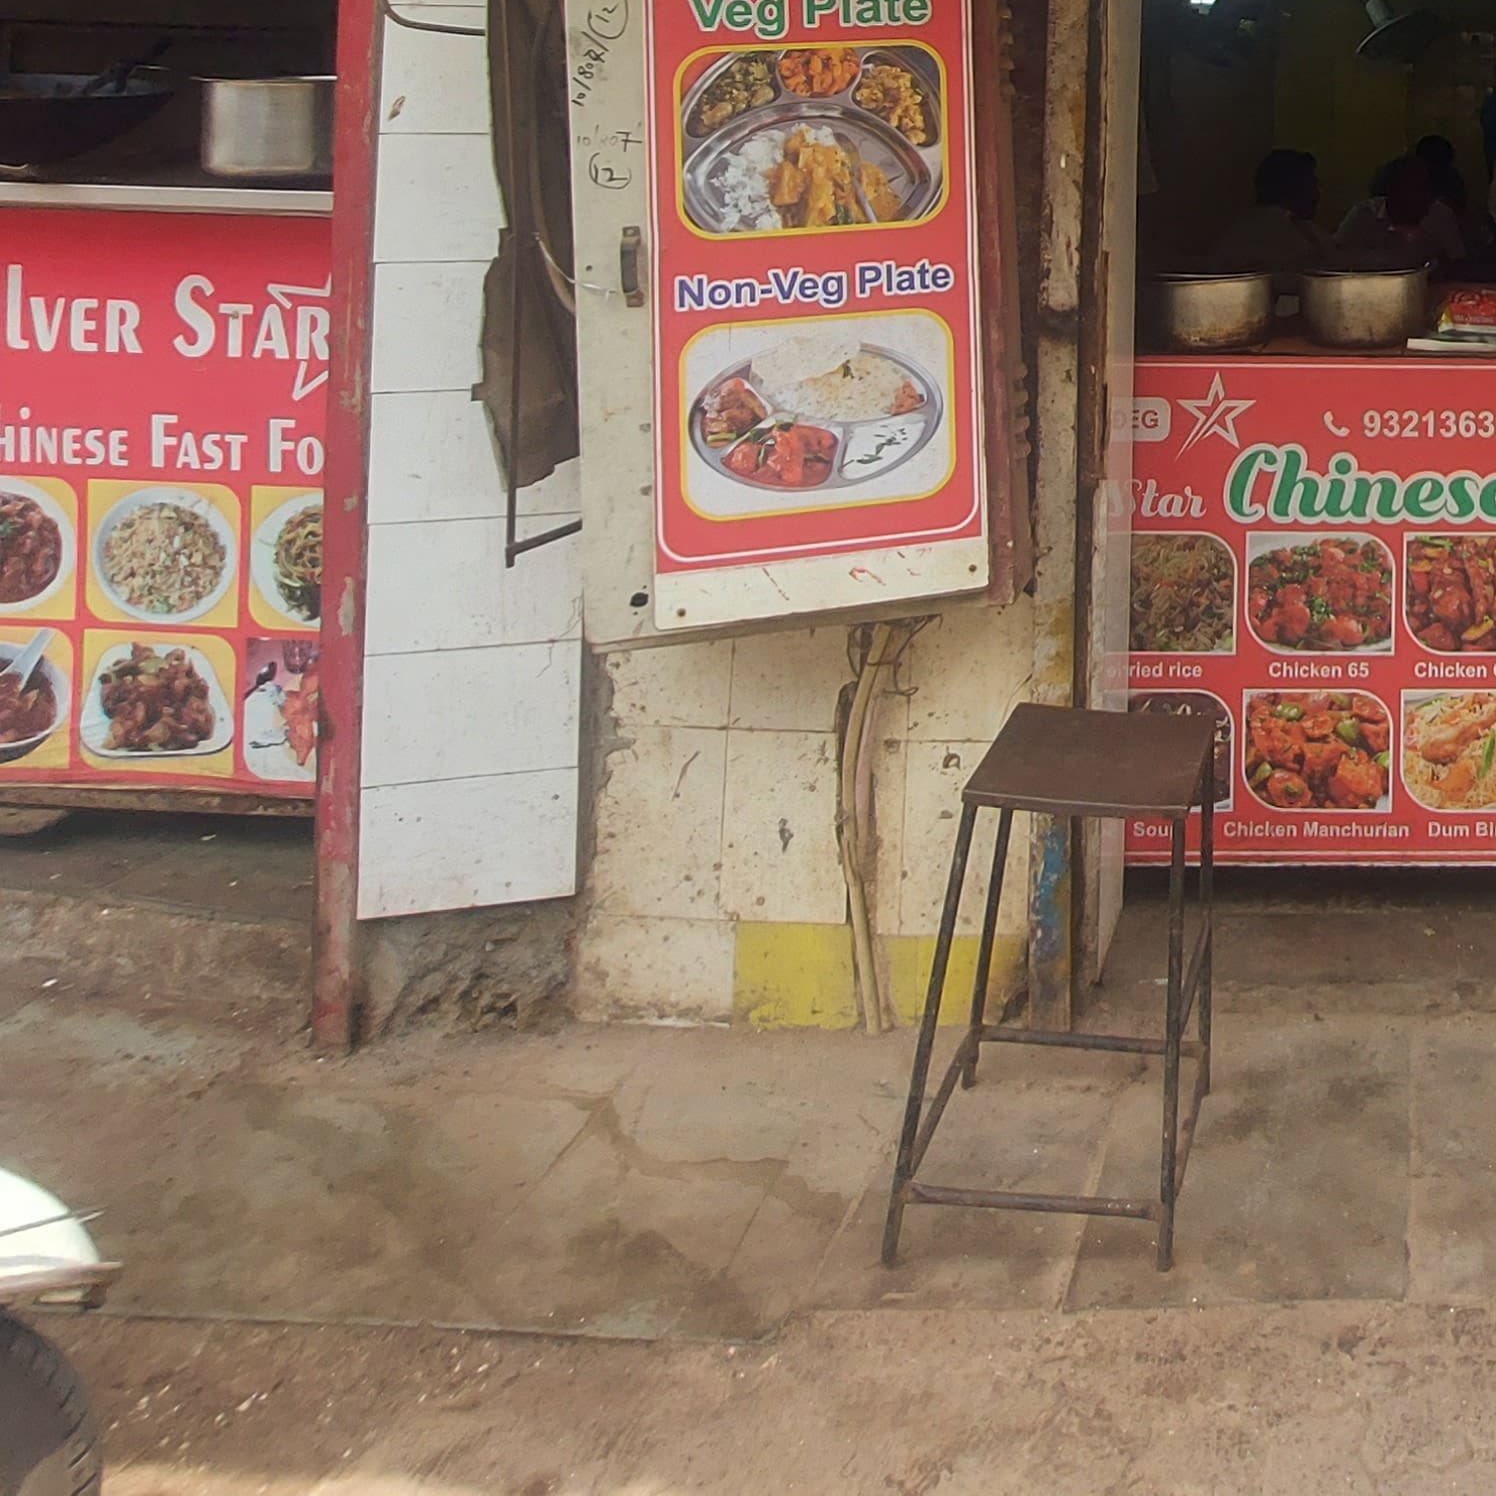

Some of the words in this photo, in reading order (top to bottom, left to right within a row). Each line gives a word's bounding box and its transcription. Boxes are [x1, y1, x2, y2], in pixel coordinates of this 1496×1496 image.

[675, 268, 848, 312] Non-Veg
[857, 258, 955, 299] Plate
[1119, 661, 1163, 678] ried
[1169, 662, 1203, 678] rice
[1269, 662, 1342, 678] Chicken
[1347, 662, 1369, 678] 65
[1414, 661, 1487, 678] Chicken
[1133, 821, 1173, 838] Sou
[1223, 821, 1297, 839] Chicken
[1303, 821, 1410, 839] Manchurian
[1428, 821, 1469, 837] Dum
